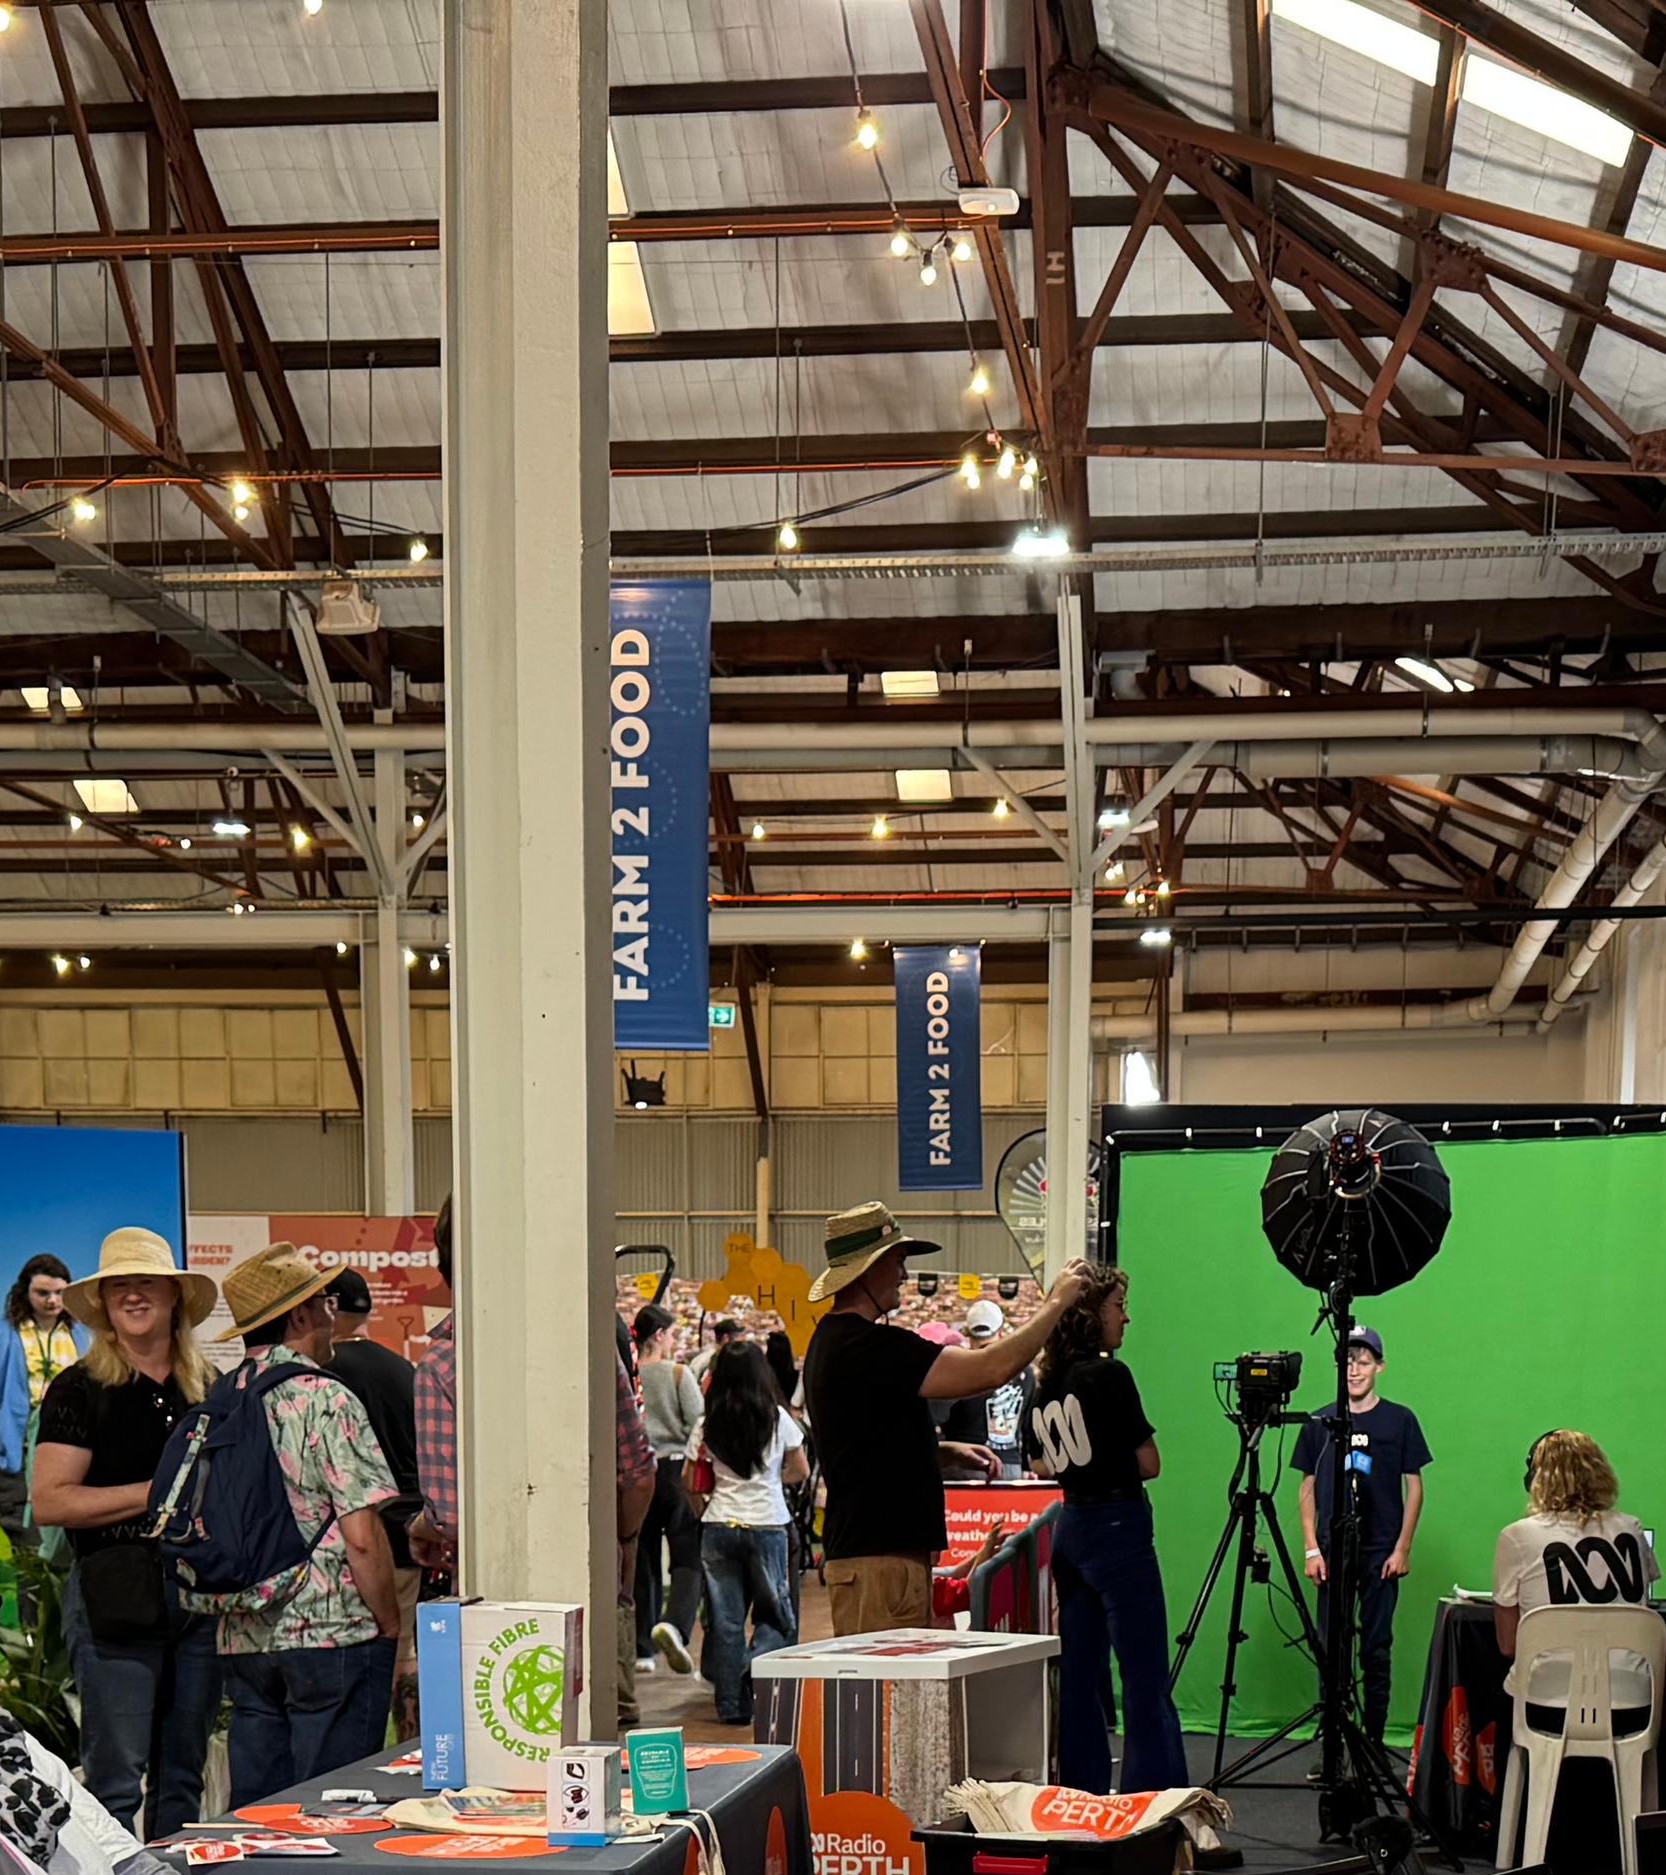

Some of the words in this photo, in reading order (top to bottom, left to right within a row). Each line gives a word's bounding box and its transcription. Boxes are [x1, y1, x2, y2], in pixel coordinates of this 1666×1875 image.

[610, 629, 651, 788] FOOD
[611, 807, 649, 837] 2
[612, 855, 649, 1000] FARM
[926, 971, 950, 1055] FOOD
[927, 1064, 950, 1079] 2
[928, 1089, 951, 1166] FARM
[298, 1245, 439, 1273] Compost
[488, 1618, 540, 1656] FIBRE
[474, 1656, 551, 1763] RESPONSIBLE
[435, 1733, 449, 1781] FUTURE
[827, 1833, 886, 1855] Radio
